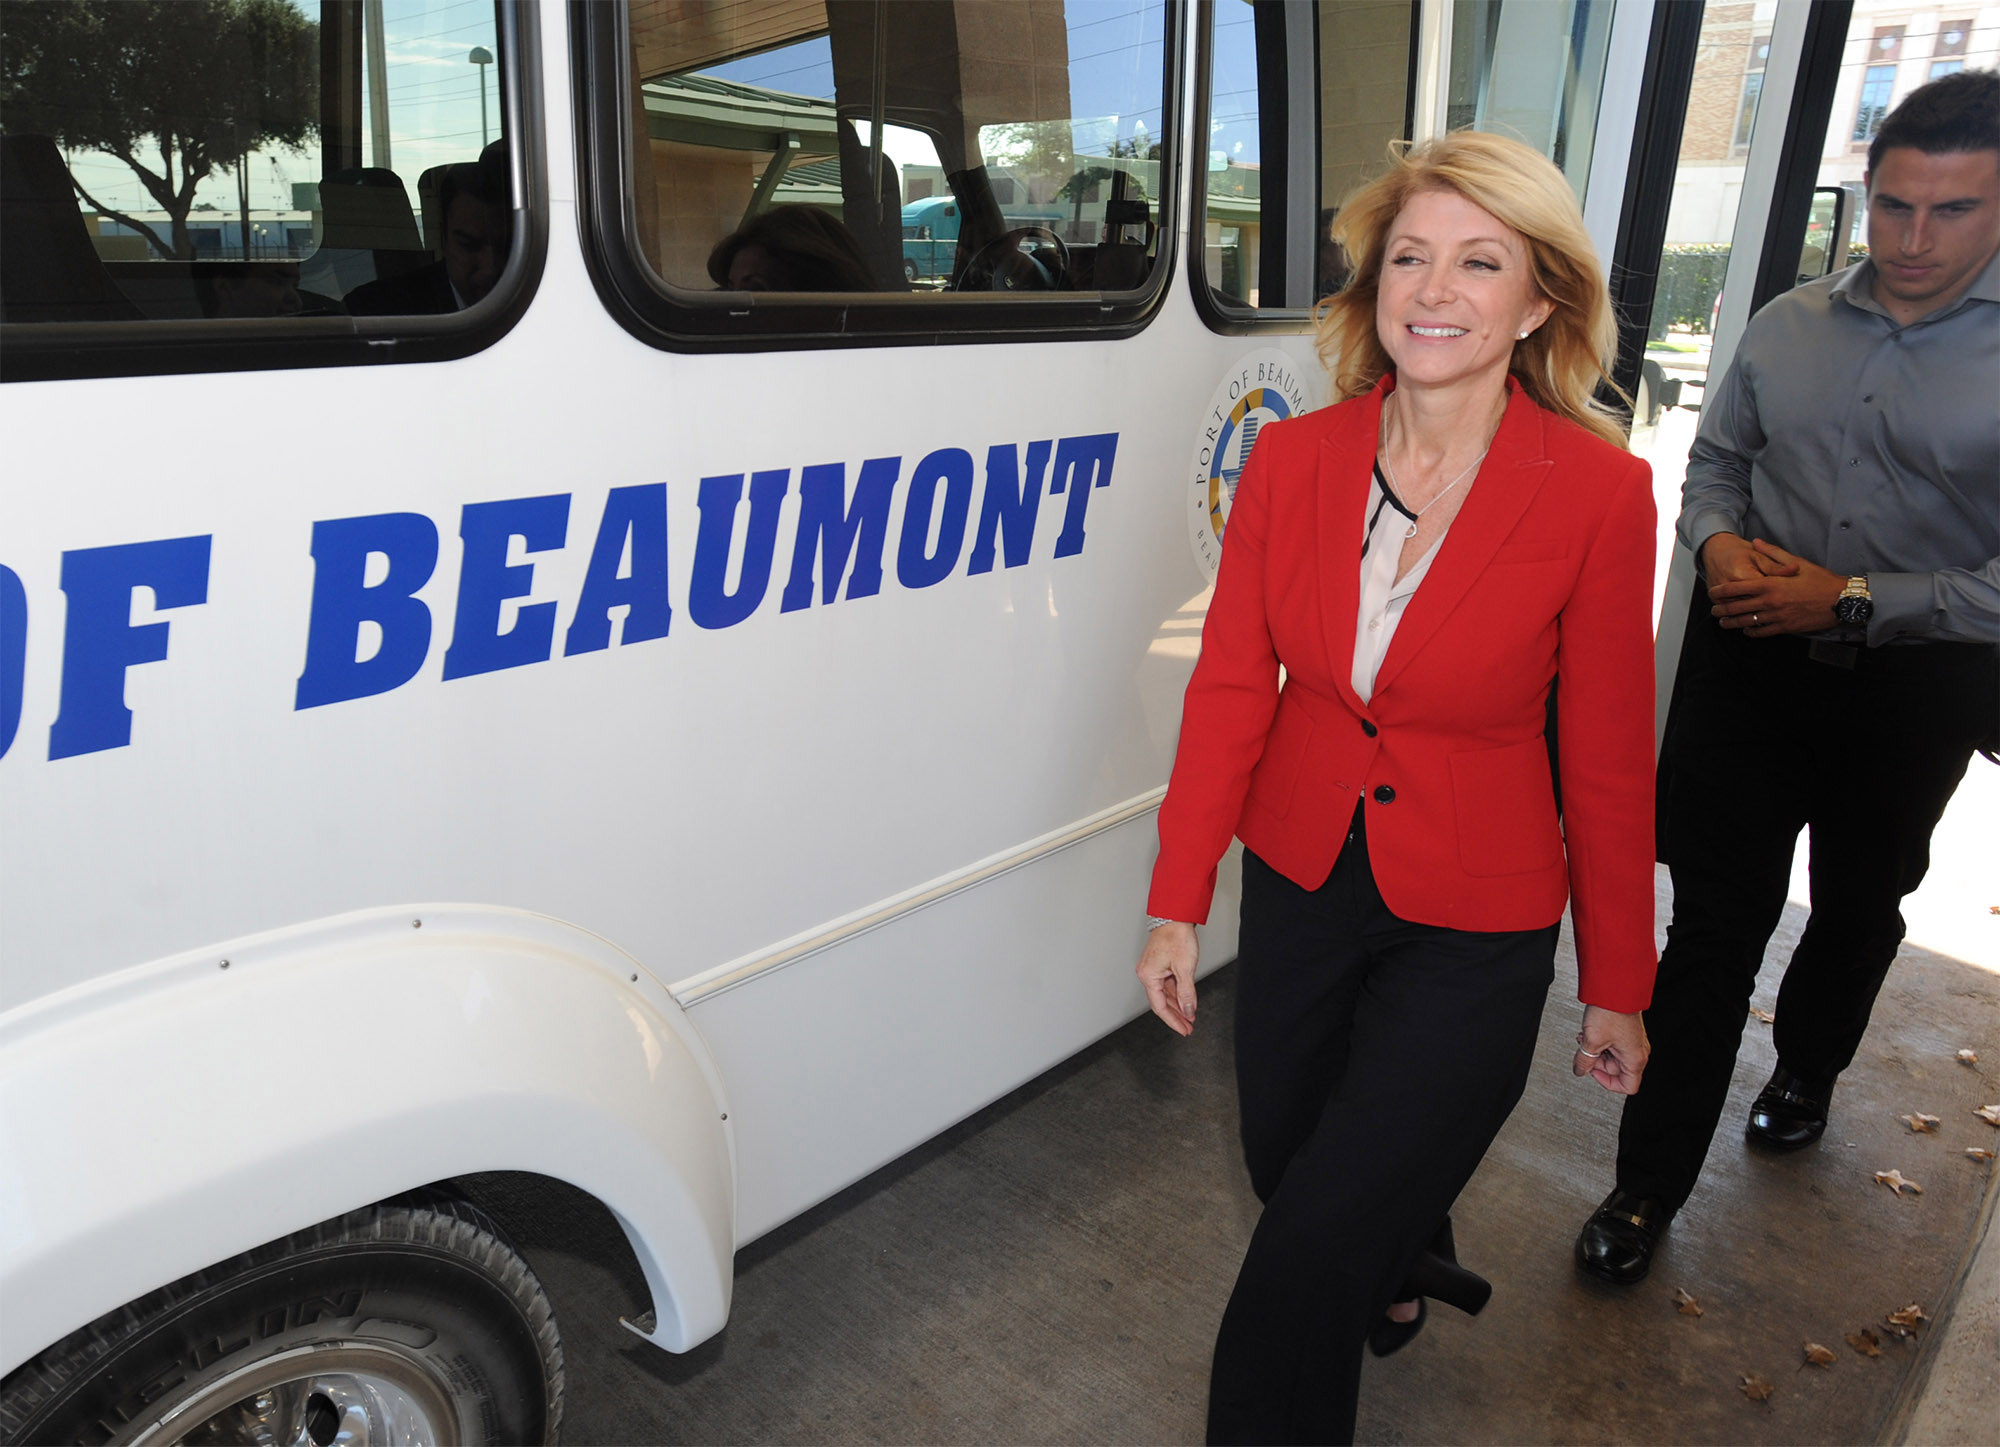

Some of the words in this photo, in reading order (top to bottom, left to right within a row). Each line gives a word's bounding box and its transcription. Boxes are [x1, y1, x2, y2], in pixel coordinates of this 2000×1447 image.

[1196, 404, 1224, 484] PORT
[1229, 369, 1249, 400] OF
[0, 534, 212, 761] F
[296, 434, 1118, 711] BEAUMONT
